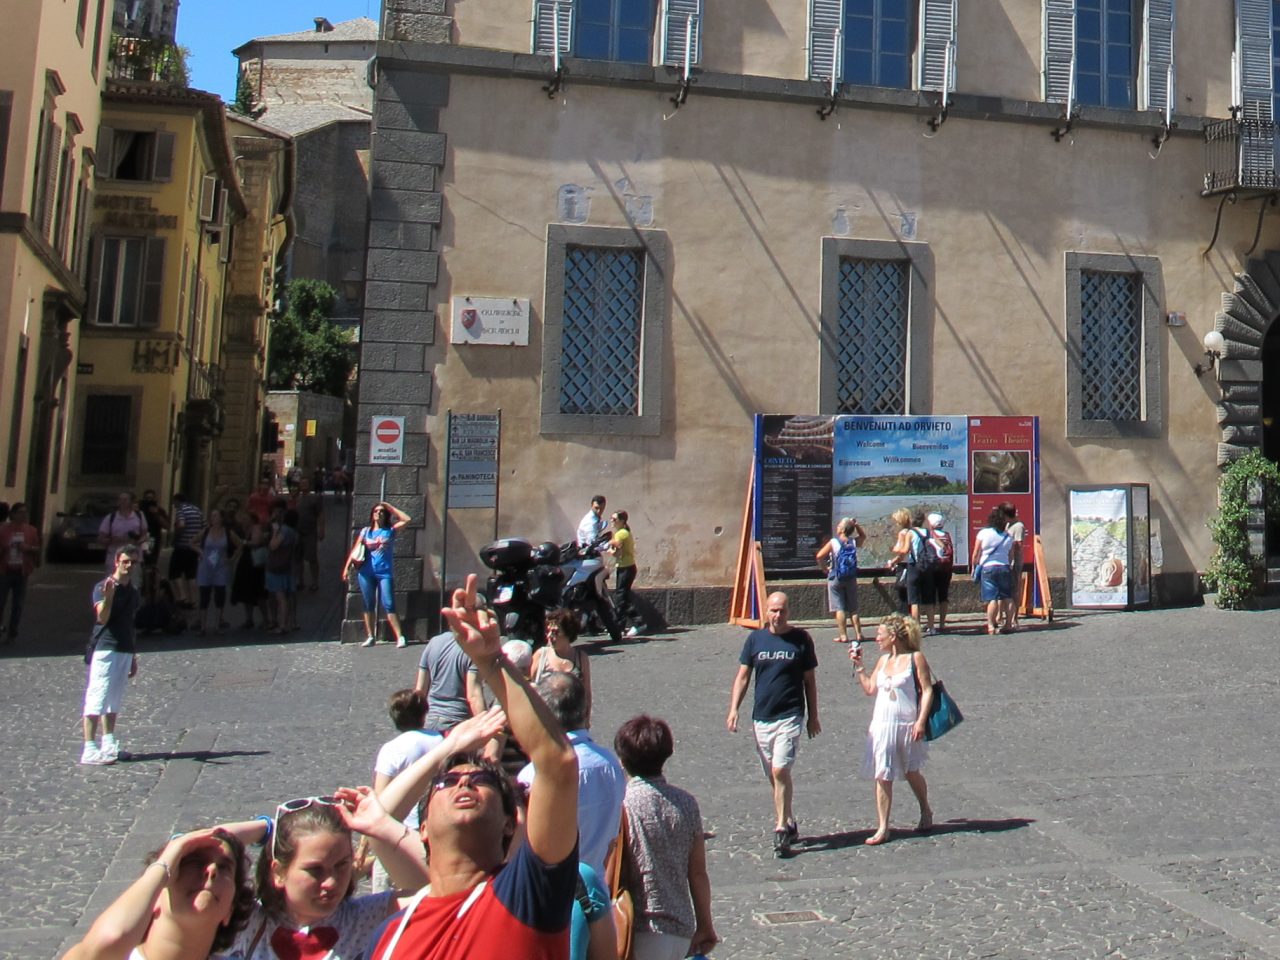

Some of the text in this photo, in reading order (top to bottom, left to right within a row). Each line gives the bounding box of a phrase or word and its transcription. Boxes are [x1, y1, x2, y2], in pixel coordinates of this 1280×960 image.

[94, 194, 159, 212] HOTEL
[844, 421, 952, 431] BENVENUTI AD ORVIETO
[857, 440, 886, 448] Welcome
[972, 434, 998, 444] Teatro
[458, 473, 495, 481] PANINOTECA
